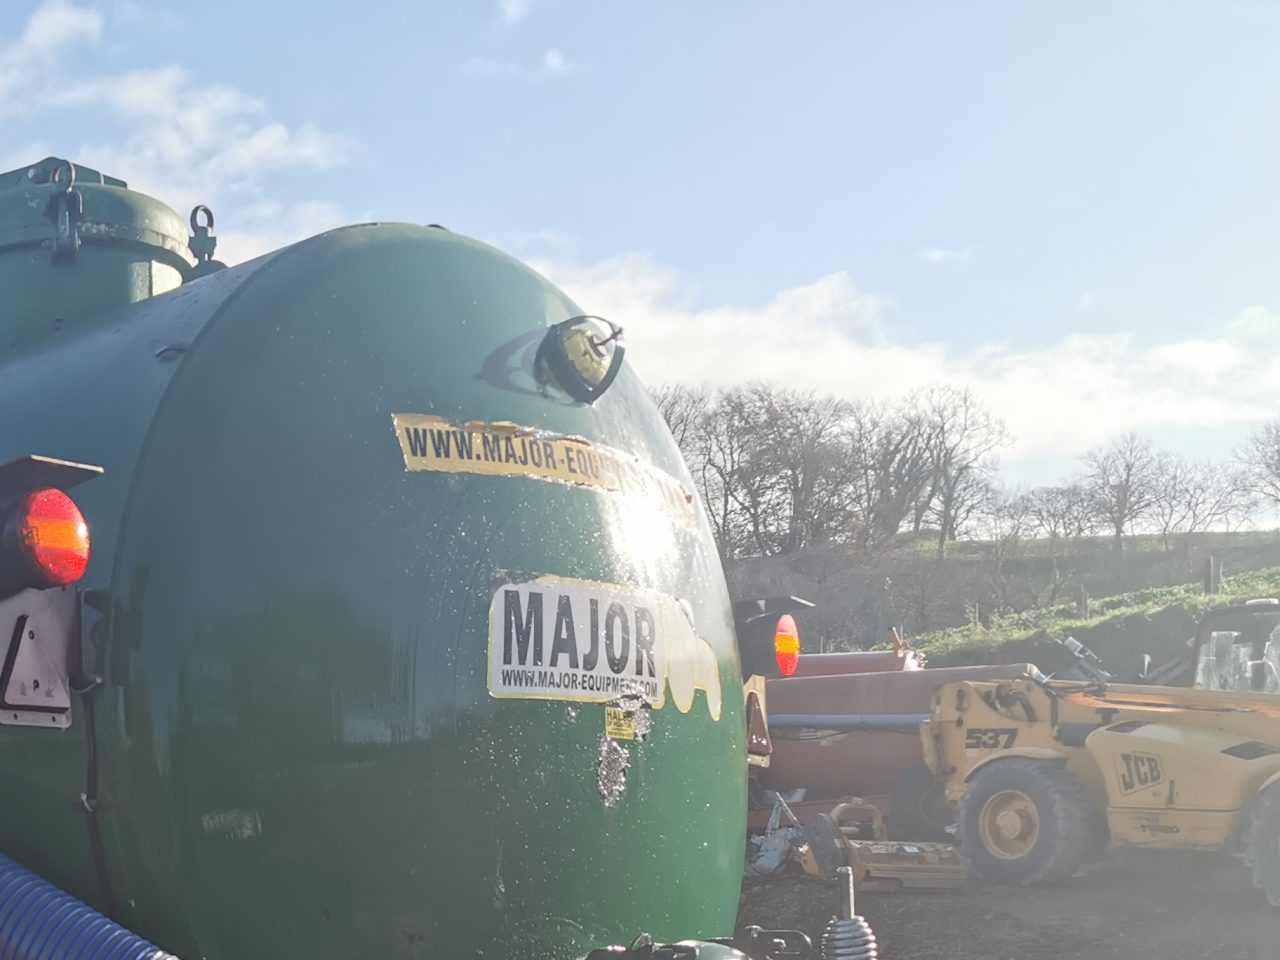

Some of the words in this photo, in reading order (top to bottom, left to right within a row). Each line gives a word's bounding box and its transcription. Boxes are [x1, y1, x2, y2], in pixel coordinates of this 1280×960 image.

[501, 589, 657, 678] MAJOR
[501, 669, 658, 699] WWW.MAJOR-EQUIPMENCOM
[965, 728, 1018, 749] 537
[1120, 752, 1161, 791] JCB
